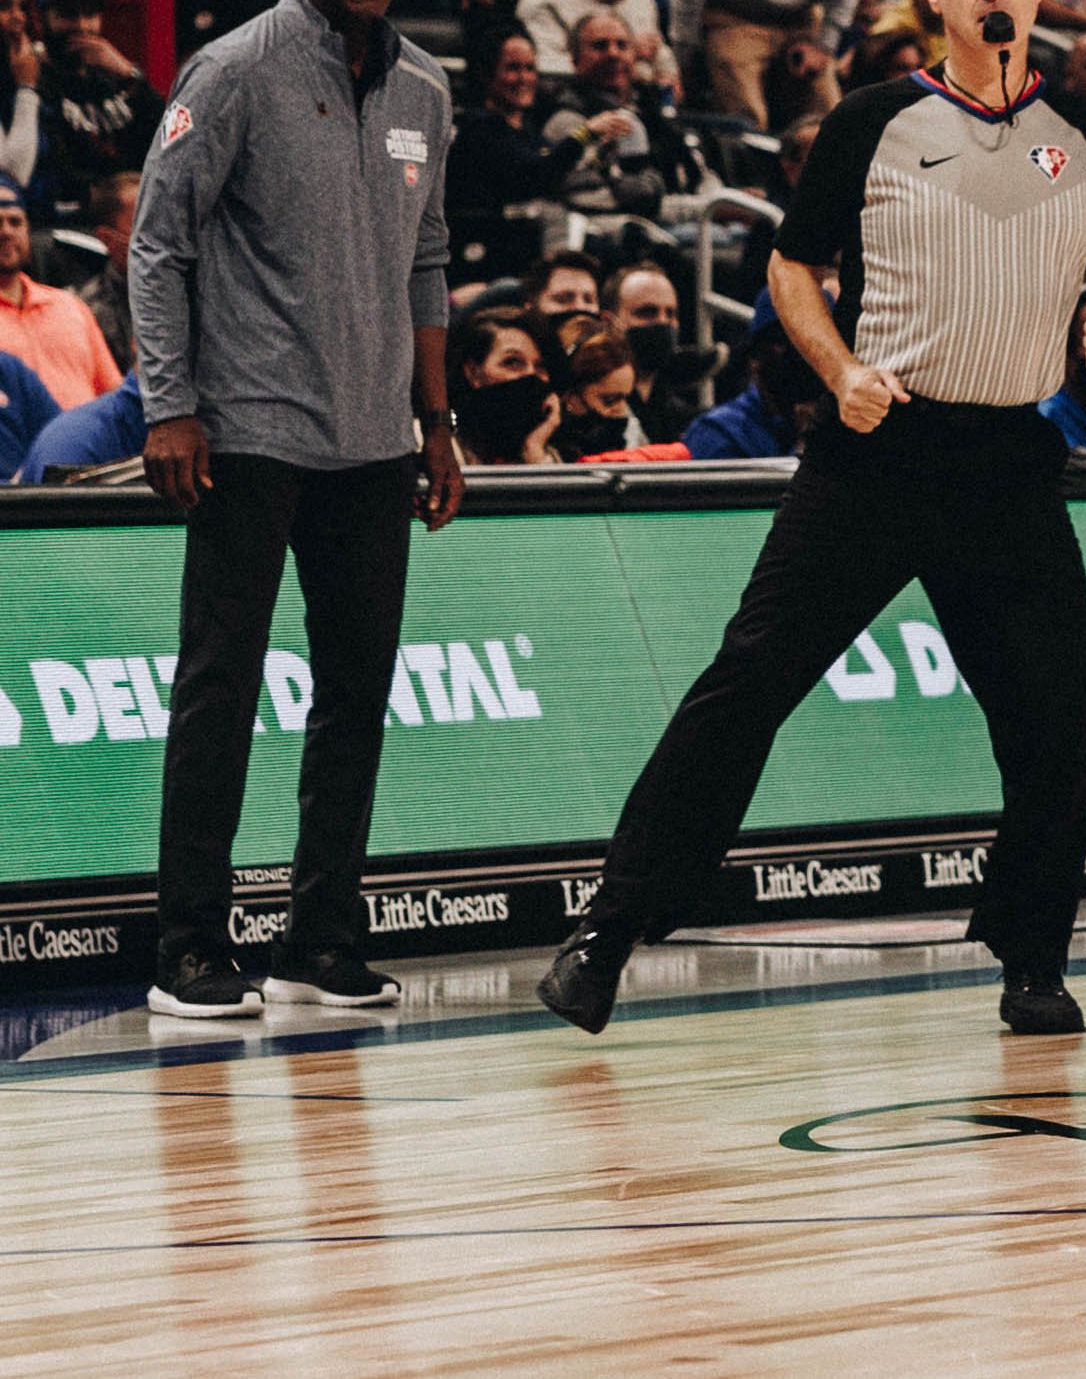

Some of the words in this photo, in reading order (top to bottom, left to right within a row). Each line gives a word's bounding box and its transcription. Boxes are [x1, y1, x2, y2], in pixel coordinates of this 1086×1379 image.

[30, 654, 267, 744] DEL
[264, 641, 543, 731] DNTAL
[231, 867, 293, 884] TRONIC
[752, 863, 807, 902] Little
[805, 860, 882, 898] Caesars
[920, 850, 973, 888] Little
[366, 894, 427, 933] Little
[425, 888, 509, 927] Caesars
[559, 876, 604, 918] Lit
[28, 920, 119, 960] Caesars
[227, 905, 289, 946] Caes
